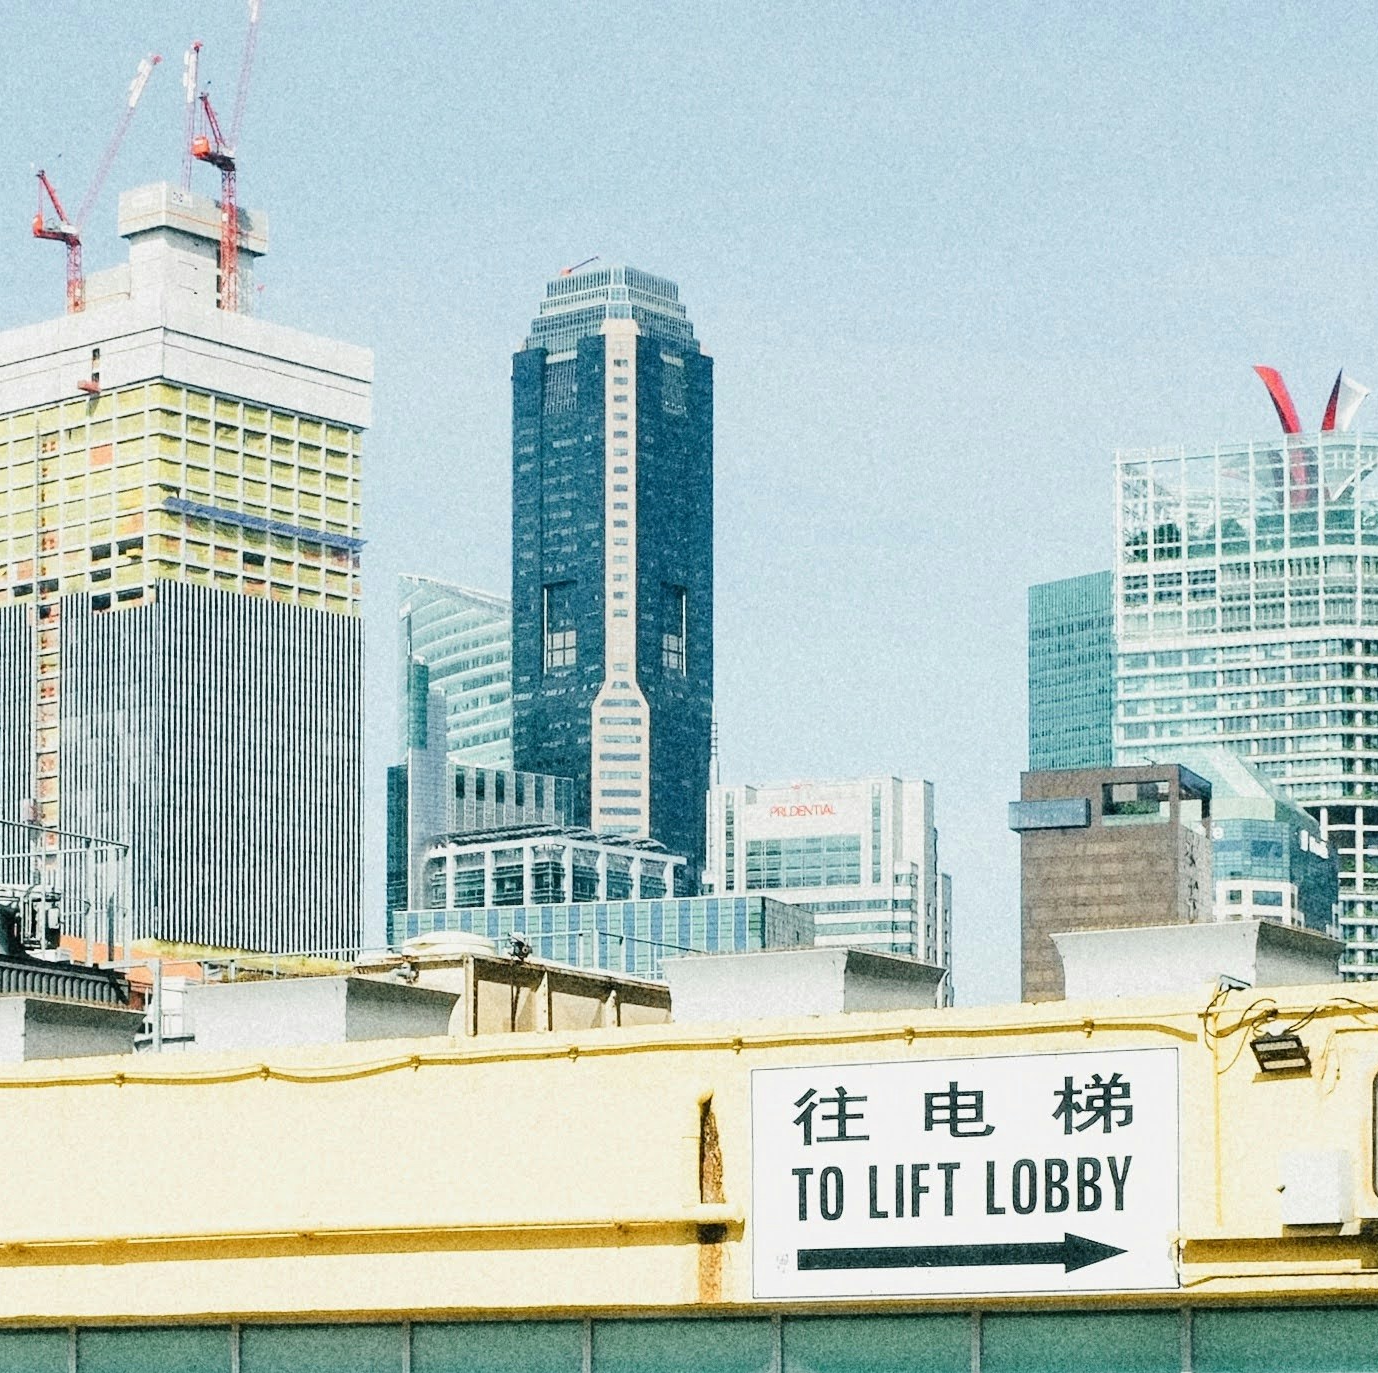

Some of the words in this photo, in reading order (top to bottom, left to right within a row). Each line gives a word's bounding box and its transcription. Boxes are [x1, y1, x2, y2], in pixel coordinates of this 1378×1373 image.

[792, 1166, 844, 1221] TO
[868, 1162, 961, 1219] LIFT
[986, 1156, 1132, 1215] LOBBY
